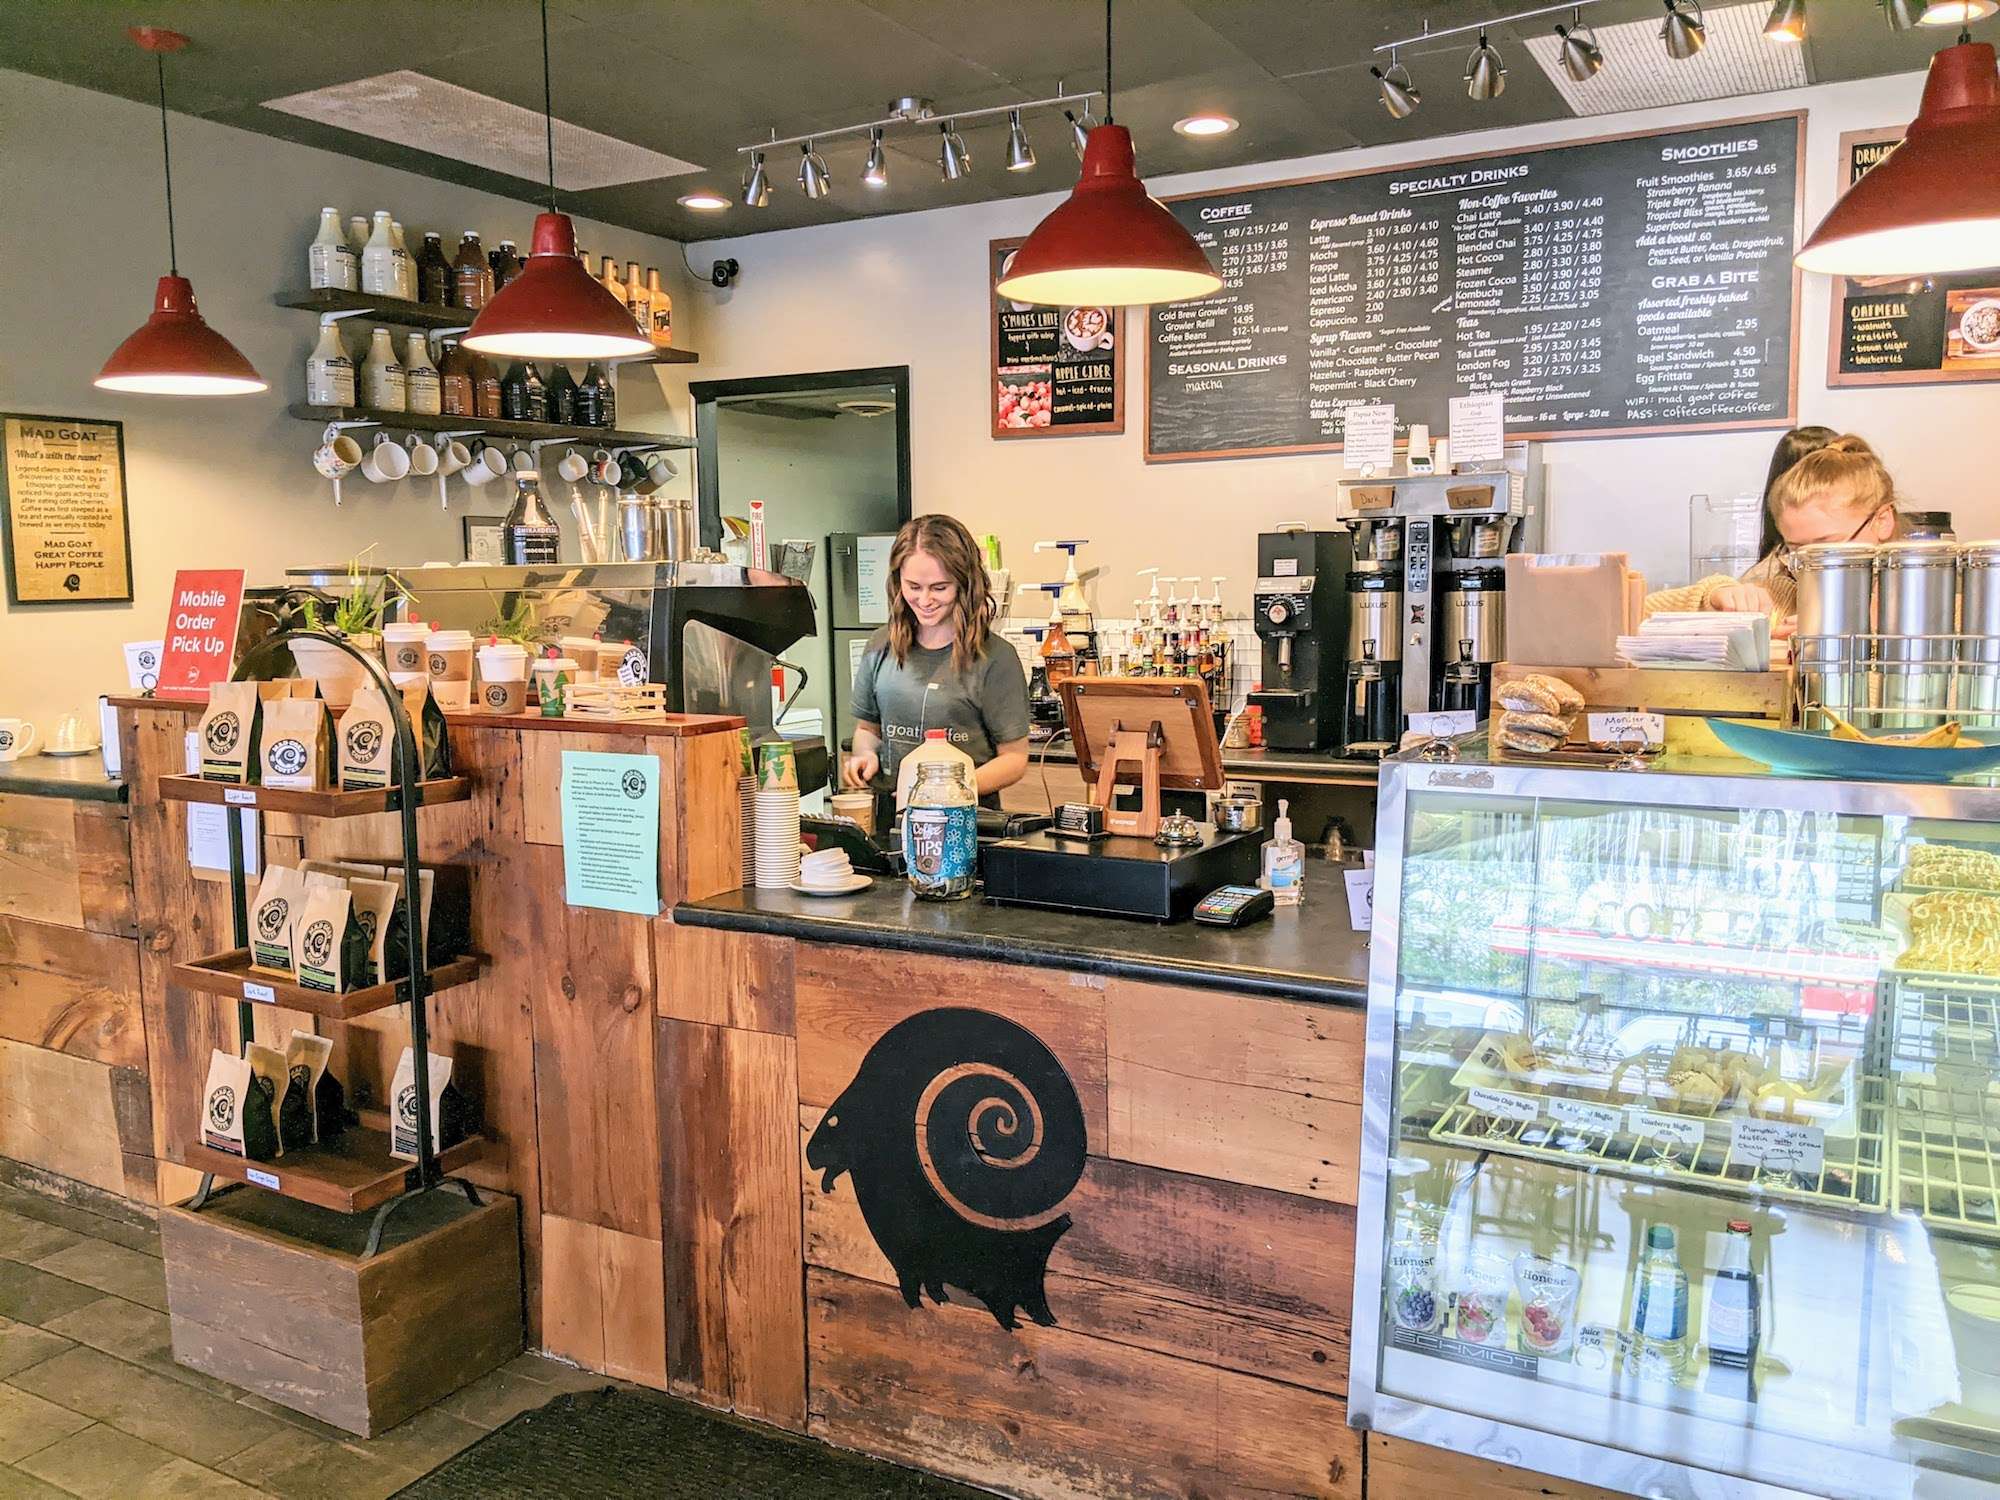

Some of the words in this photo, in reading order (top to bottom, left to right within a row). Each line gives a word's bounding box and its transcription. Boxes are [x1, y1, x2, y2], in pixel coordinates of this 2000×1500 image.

[1662, 139, 1758, 161] SMOOTHIES
[1389, 174, 1467, 194] SPECIALTY
[1471, 165, 1529, 183] DRINKS
[1636, 176, 1658, 188] Fruit
[1661, 172, 1714, 185] Smoothies
[1754, 164, 1776, 175] 4.65
[1512, 189, 1558, 203] Favorites
[1646, 186, 1696, 198] Strawberry
[1697, 182, 1732, 192] Banana
[1200, 204, 1252, 220] COFFEE
[1647, 200, 1670, 210] Triple
[1673, 198, 1698, 208] Berry
[1310, 216, 1347, 232] Espresso
[1349, 211, 1377, 224] Based
[1379, 208, 1412, 222] Drinks
[1456, 212, 1477, 223] Chai
[1479, 210, 1502, 220] Latte
[1223, 229, 1240, 238] 1.90
[1247, 225, 1263, 235] 2.15
[1271, 222, 1288, 232] 2.40
[1222, 247, 1239, 255] 2.65
[1247, 243, 1263, 252] 3.15
[1271, 239, 1288, 249] 3.65
[1310, 251, 1338, 261] Mocha
[1367, 244, 1385, 255] 3.60
[1393, 241, 1411, 251] 4.10
[1419, 237, 1439, 248] 4.60
[1457, 242, 1493, 253] Blended
[1496, 239, 1516, 248] Chai
[1457, 255, 1473, 265] Hot
[1475, 253, 1504, 263] Cocoa
[1310, 263, 1338, 275] Frappe
[1456, 266, 1493, 278] Steamer
[1310, 275, 1327, 284] Iced
[1329, 272, 1350, 282] Latte
[1456, 278, 1486, 289] Frozen
[1488, 276, 1516, 286] Cocoa
[1652, 275, 1699, 289] GRAB
[1720, 271, 1759, 284] BITE
[1310, 286, 1327, 296] Iced
[1329, 282, 1357, 293] Mocha
[1455, 288, 1504, 299] Kombucha
[1310, 296, 1354, 306] Americano
[1159, 312, 1176, 322] Cold
[1178, 310, 1196, 319] Brew
[1198, 306, 1228, 318] Growler
[1233, 304, 1254, 314] 19.95
[1310, 306, 1345, 317] Espresso
[1365, 302, 1384, 312] 2.00
[1165, 322, 1194, 332] Growler
[1196, 319, 1215, 328] Refill
[1233, 316, 1254, 325] 14.95
[1310, 316, 1358, 328] Cappuccino
[1365, 314, 1383, 324] 2.80
[1456, 318, 1479, 328] Teas
[1638, 324, 1680, 336] Oatmeal
[1736, 318, 1757, 330] 2.95
[1158, 333, 1182, 343] Coffee
[1184, 332, 1206, 340] Beans
[1232, 325, 1260, 336] $12-14
[1456, 332, 1473, 341] Hot
[1475, 330, 1490, 339] Tea
[1524, 324, 1543, 334] 1.95
[1552, 321, 1572, 331] 2.20
[1581, 318, 1601, 328] 2.45
[1310, 333, 1337, 345] Syrup
[1339, 331, 1372, 341] Flavors
[1310, 360, 1334, 369] White
[1336, 356, 1377, 368] Chocolate
[1386, 354, 1411, 363] Butter
[1414, 351, 1440, 360] Pecan
[1637, 353, 1664, 364] Bagel
[1667, 349, 1714, 361] Sandwich
[1733, 346, 1755, 357] 4.50
[1168, 361, 1235, 375] SEASONAL
[1238, 355, 1287, 369] DRINKS
[1456, 361, 1491, 372] London
[1493, 359, 1510, 369] Fog
[1310, 368, 1346, 380] Hazelnut
[1354, 367, 1396, 377] Raspberry
[1636, 373, 1655, 384] Egg
[1657, 371, 1692, 382] Frittata
[1733, 368, 1755, 378] 3.50
[1184, 379, 1223, 392] matcha
[1364, 379, 1387, 388] Black
[1388, 377, 1417, 388] Cherry
[20, 426, 54, 439] MAD
[58, 429, 98, 441] GOAT
[179, 591, 226, 607] Mobile
[176, 613, 216, 629] Order
[172, 636, 201, 652] Pick
[204, 637, 225, 656] Up
[887, 724, 920, 738] goat
[914, 837, 942, 857] TIPS
